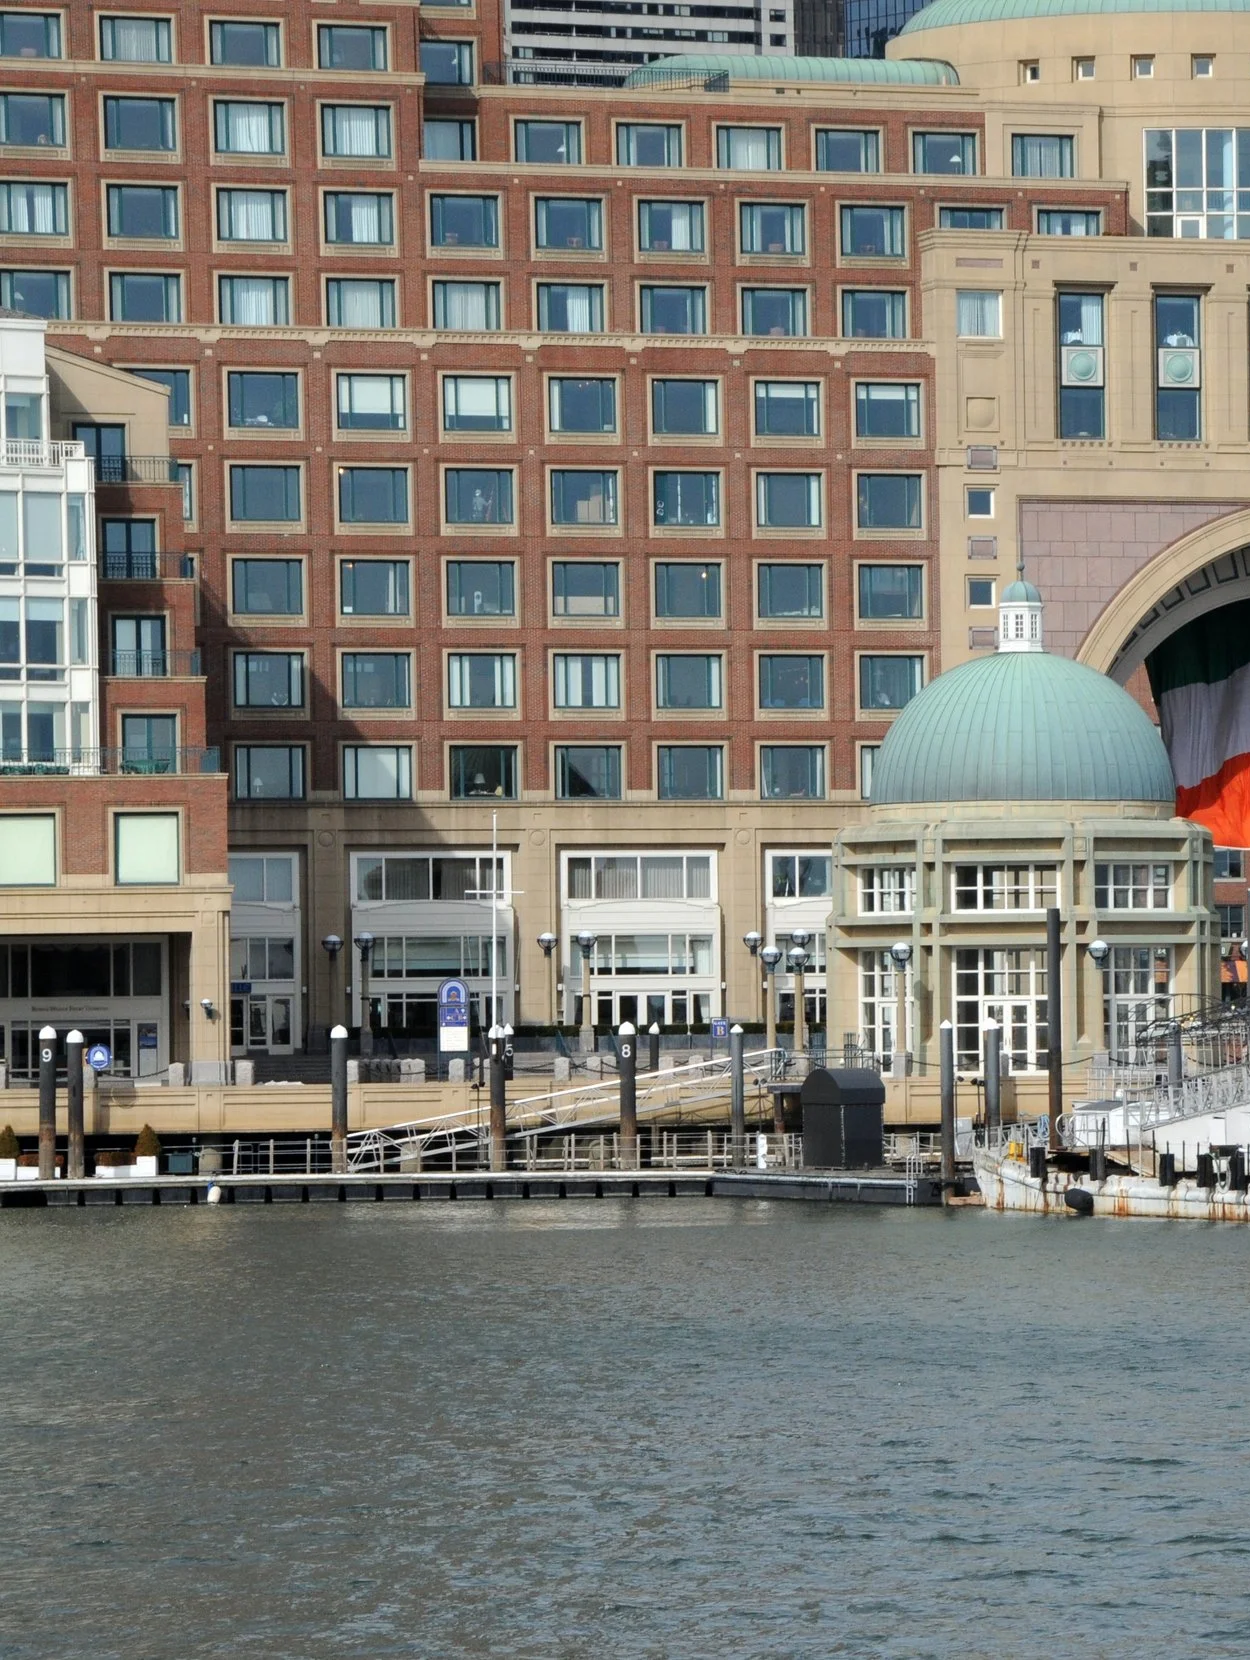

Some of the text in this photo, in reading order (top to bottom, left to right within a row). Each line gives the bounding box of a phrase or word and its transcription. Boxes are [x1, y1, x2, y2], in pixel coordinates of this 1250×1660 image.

[716, 1026, 725, 1035] B
[42, 1048, 52, 1062] 9
[506, 1044, 513, 1056] 5
[621, 1044, 631, 1058] 8
